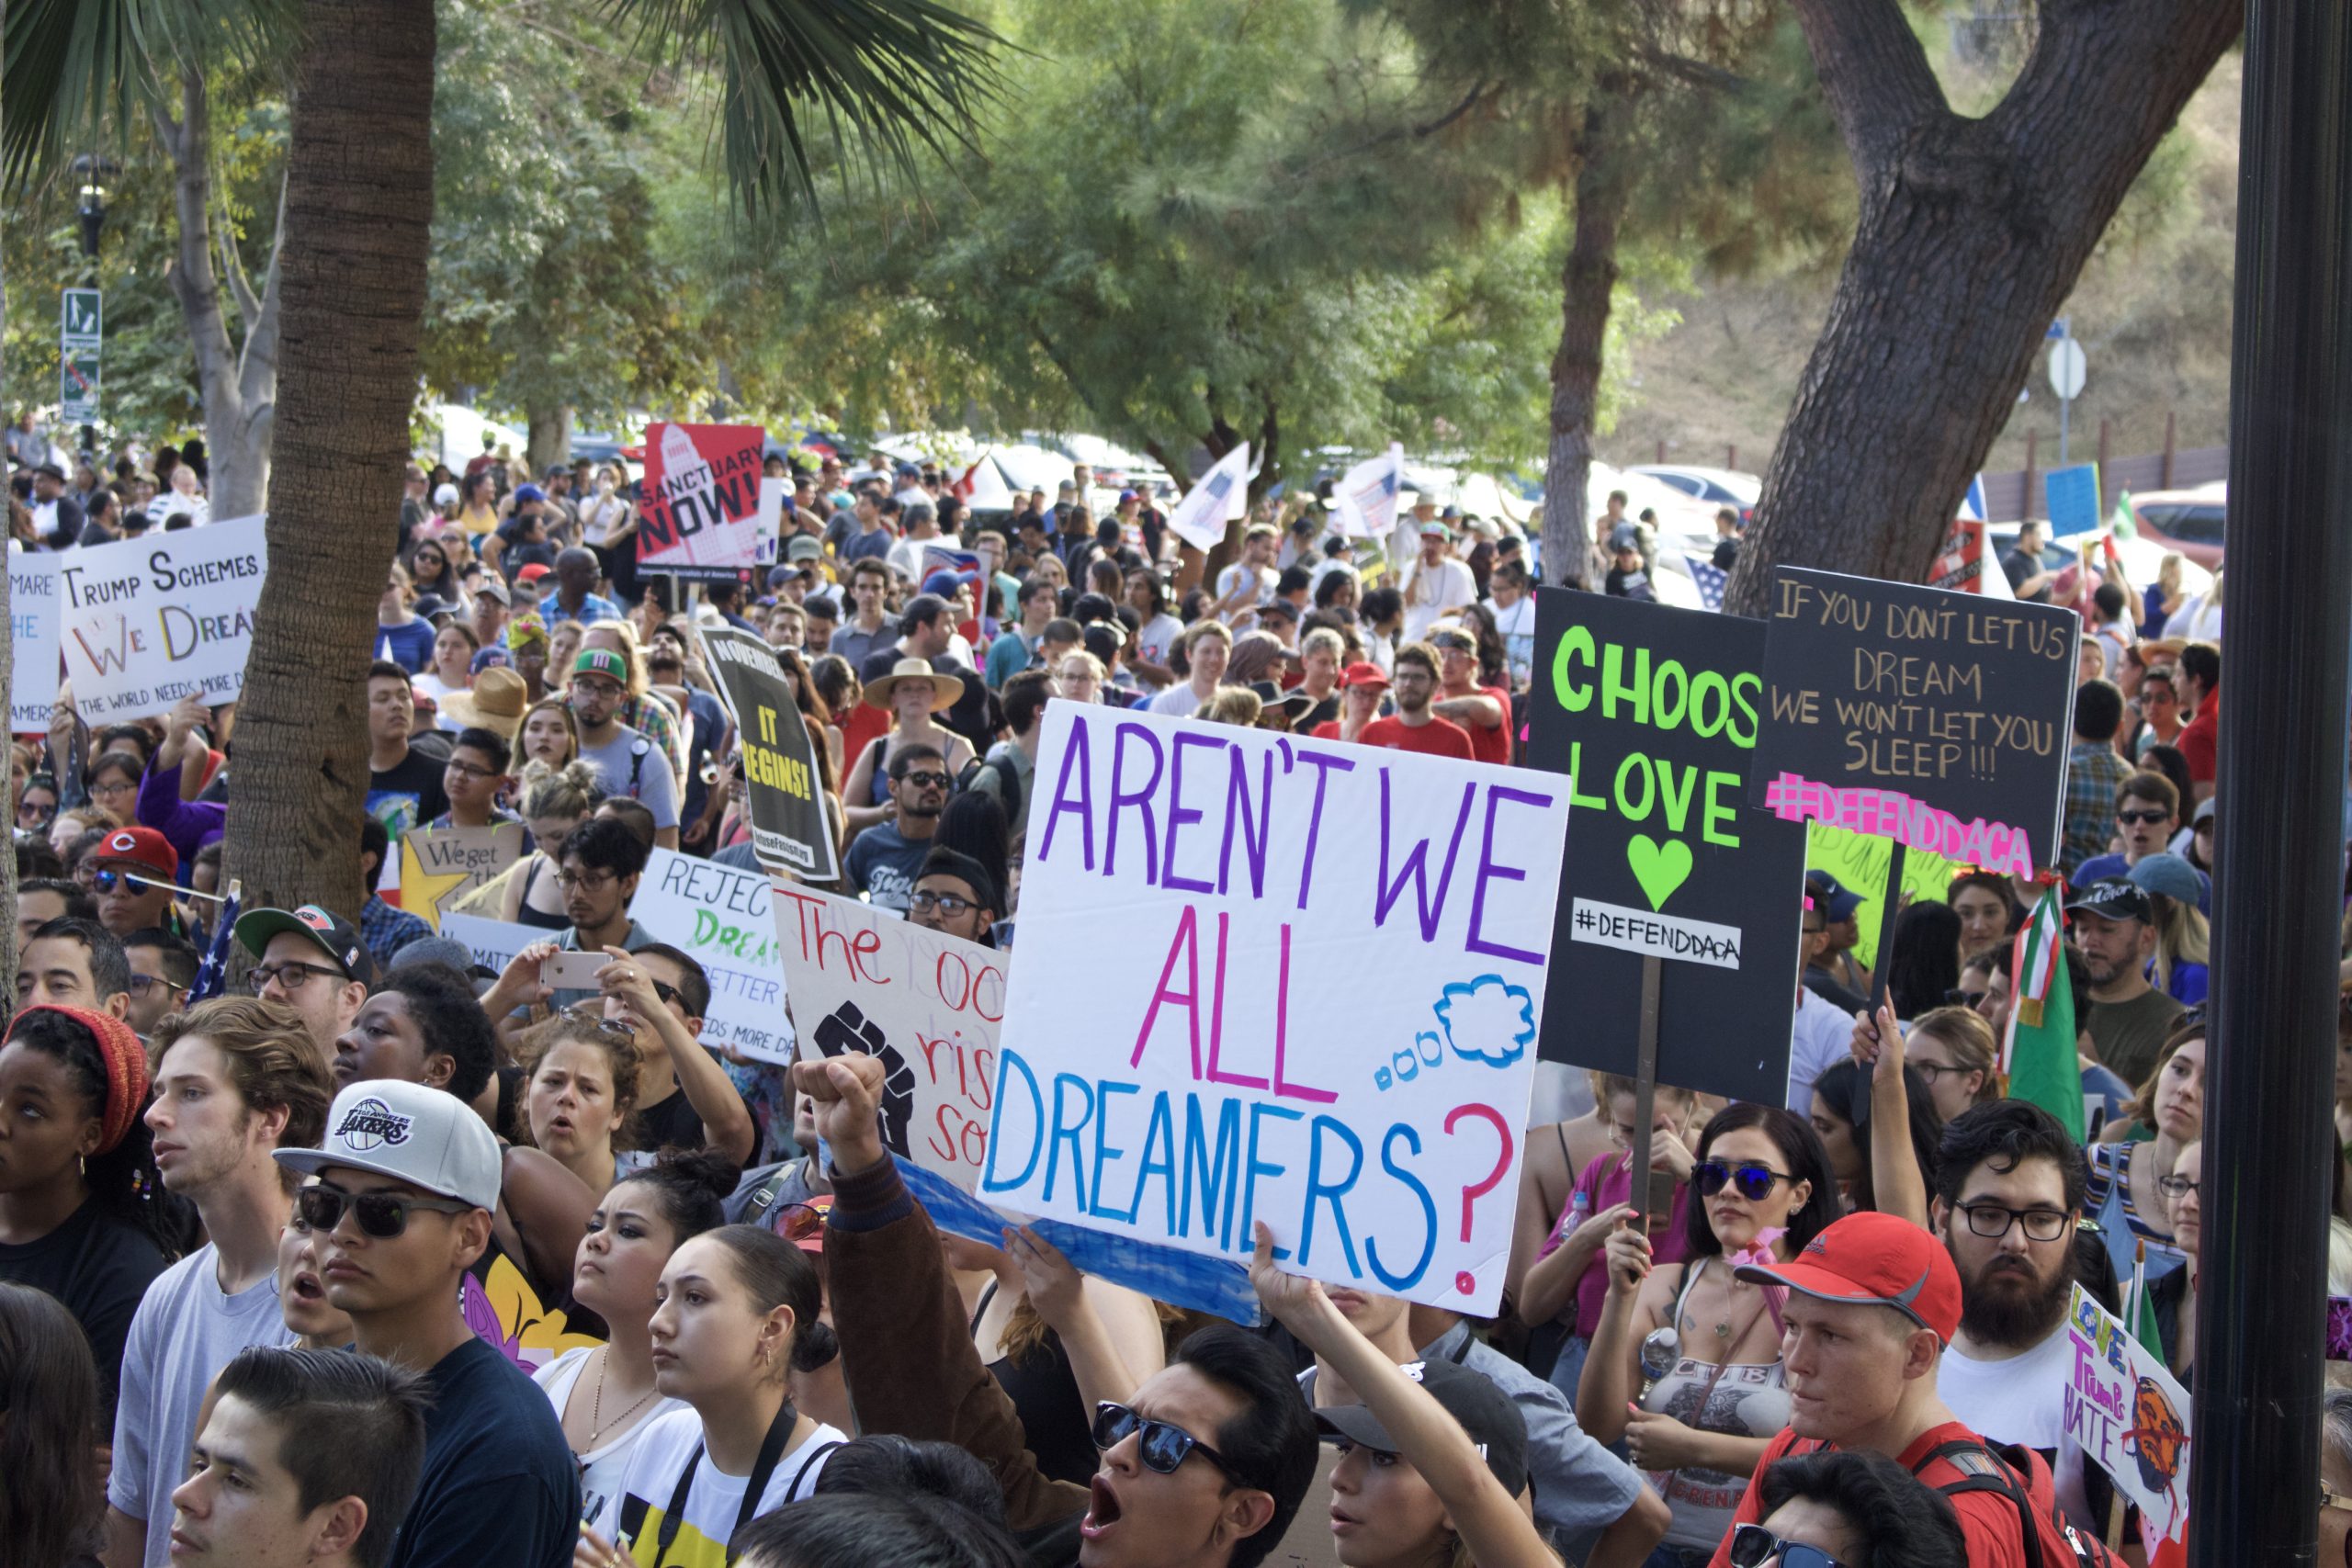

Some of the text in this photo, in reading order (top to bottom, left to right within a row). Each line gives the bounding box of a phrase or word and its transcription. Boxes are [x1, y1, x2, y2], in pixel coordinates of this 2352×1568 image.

[642, 443, 763, 507] SANCTUARY
[639, 471, 760, 554] NOW!
[9, 573, 53, 596] MARE
[62, 567, 141, 608] TRUMP
[11, 615, 39, 638] HE
[158, 604, 257, 661] DREA
[1775, 579, 2065, 660] IF YOU DON'T LET US
[79, 697, 105, 716] THE
[107, 690, 150, 710] WORLD
[154, 680, 198, 702] NEEDS
[200, 673, 232, 695] MORE
[1553, 625, 1762, 748] CHOOS
[1854, 647, 1982, 703] DREAM
[11, 705, 53, 722] AMERS
[758, 705, 776, 746] IT
[1771, 684, 2053, 756] WE WON'T LET YOU
[741, 738, 811, 801] BEGINS!
[1570, 742, 1741, 848] LOVE
[1038, 716, 1554, 965] AREN'T WE
[1766, 772, 2033, 882] #DEFENDDACA
[662, 858, 772, 917] REJEC
[685, 908, 780, 967] DREA
[773, 888, 891, 984] The
[1576, 908, 1740, 962] #DEFENDDACA
[704, 1017, 729, 1039] EDS
[732, 1025, 773, 1050] MORE
[1130, 905, 1339, 1104] ALL
[915, 1030, 994, 1111] ris
[334, 1109, 409, 1145] LAKERS
[2071, 1284, 2127, 1376] LOVE
[2064, 1382, 2120, 1472] HATE
